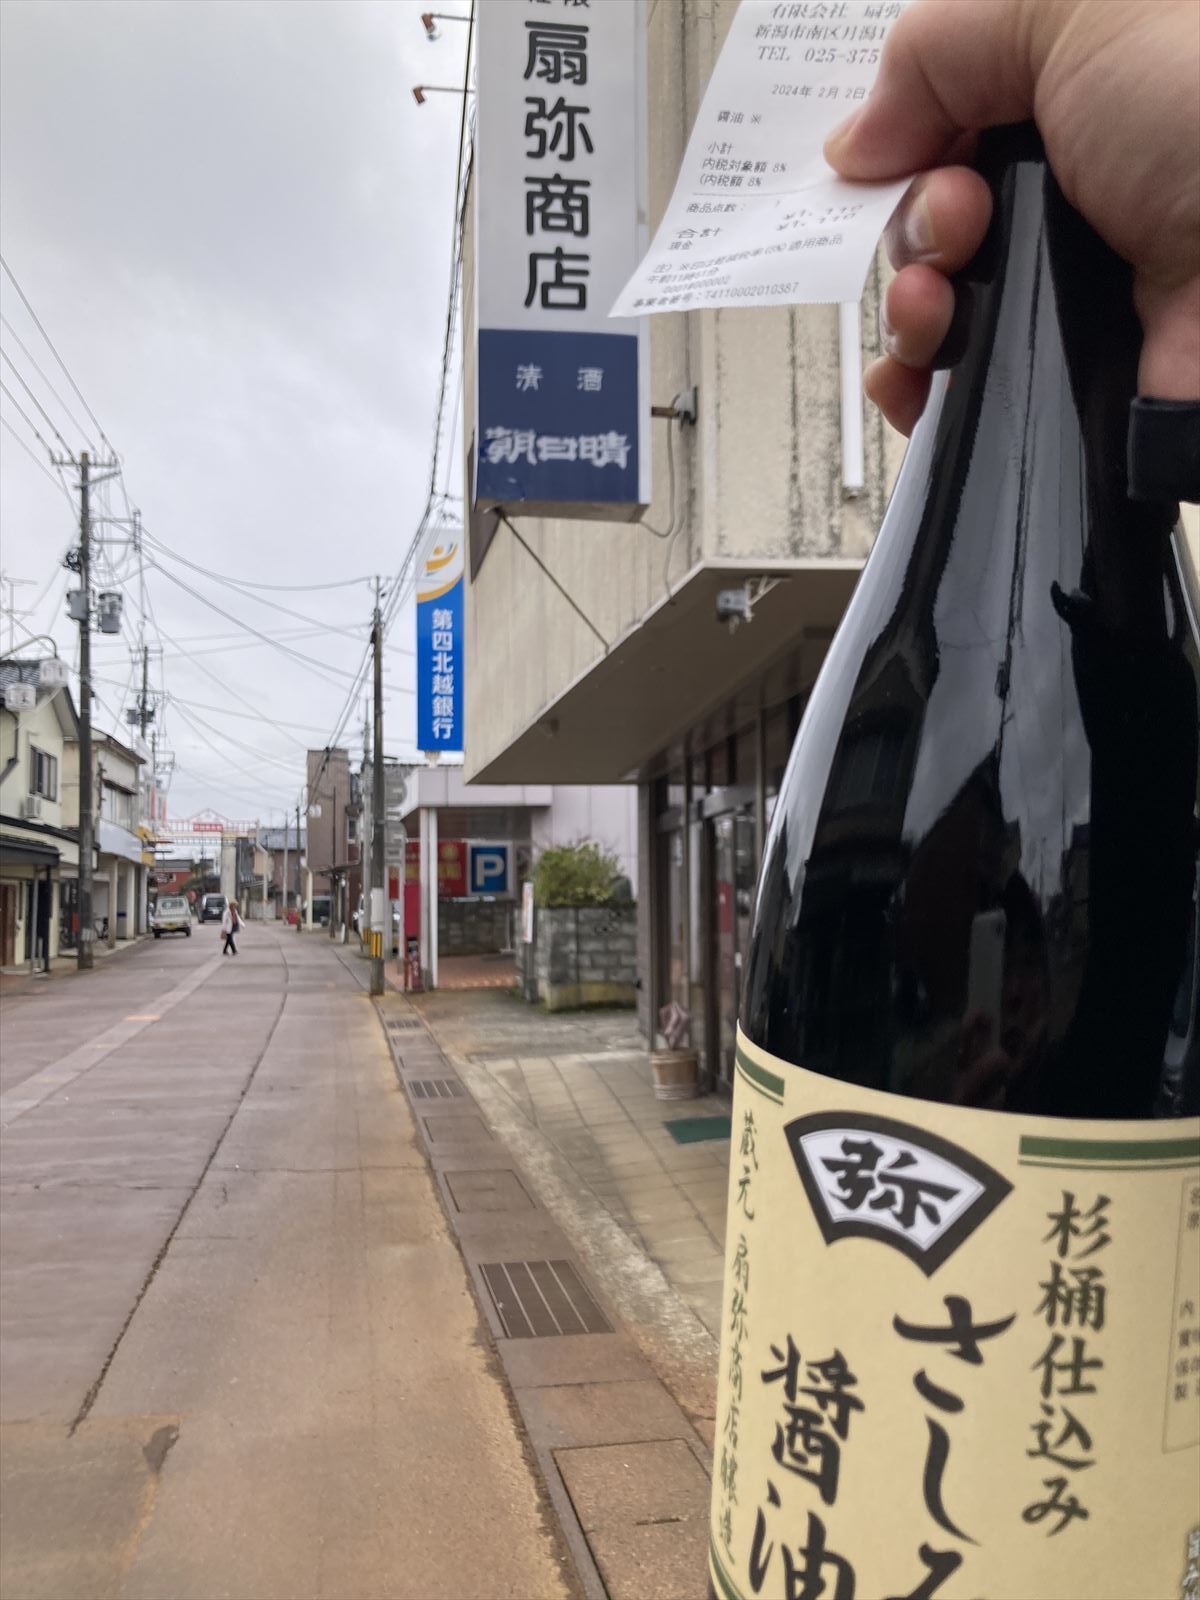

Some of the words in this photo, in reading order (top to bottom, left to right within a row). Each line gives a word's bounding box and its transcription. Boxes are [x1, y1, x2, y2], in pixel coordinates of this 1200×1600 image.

[758, 46, 790, 61] TEL
[804, 48, 880, 64] 025-375
[771, 84, 813, 97] 2024年
[818, 87, 839, 99] 2月
[707, 142, 733, 155] 小計
[525, 20, 593, 311] 扇弥商店
[677, 227, 723, 239] 合計
[516, 363, 604, 392] 清酒
[432, 608, 454, 740] 第四北越銀行
[476, 853, 505, 887] P
[820, 1137, 961, 1229] 弥
[1021, 1189, 1113, 1538] 杉桶仕込み
